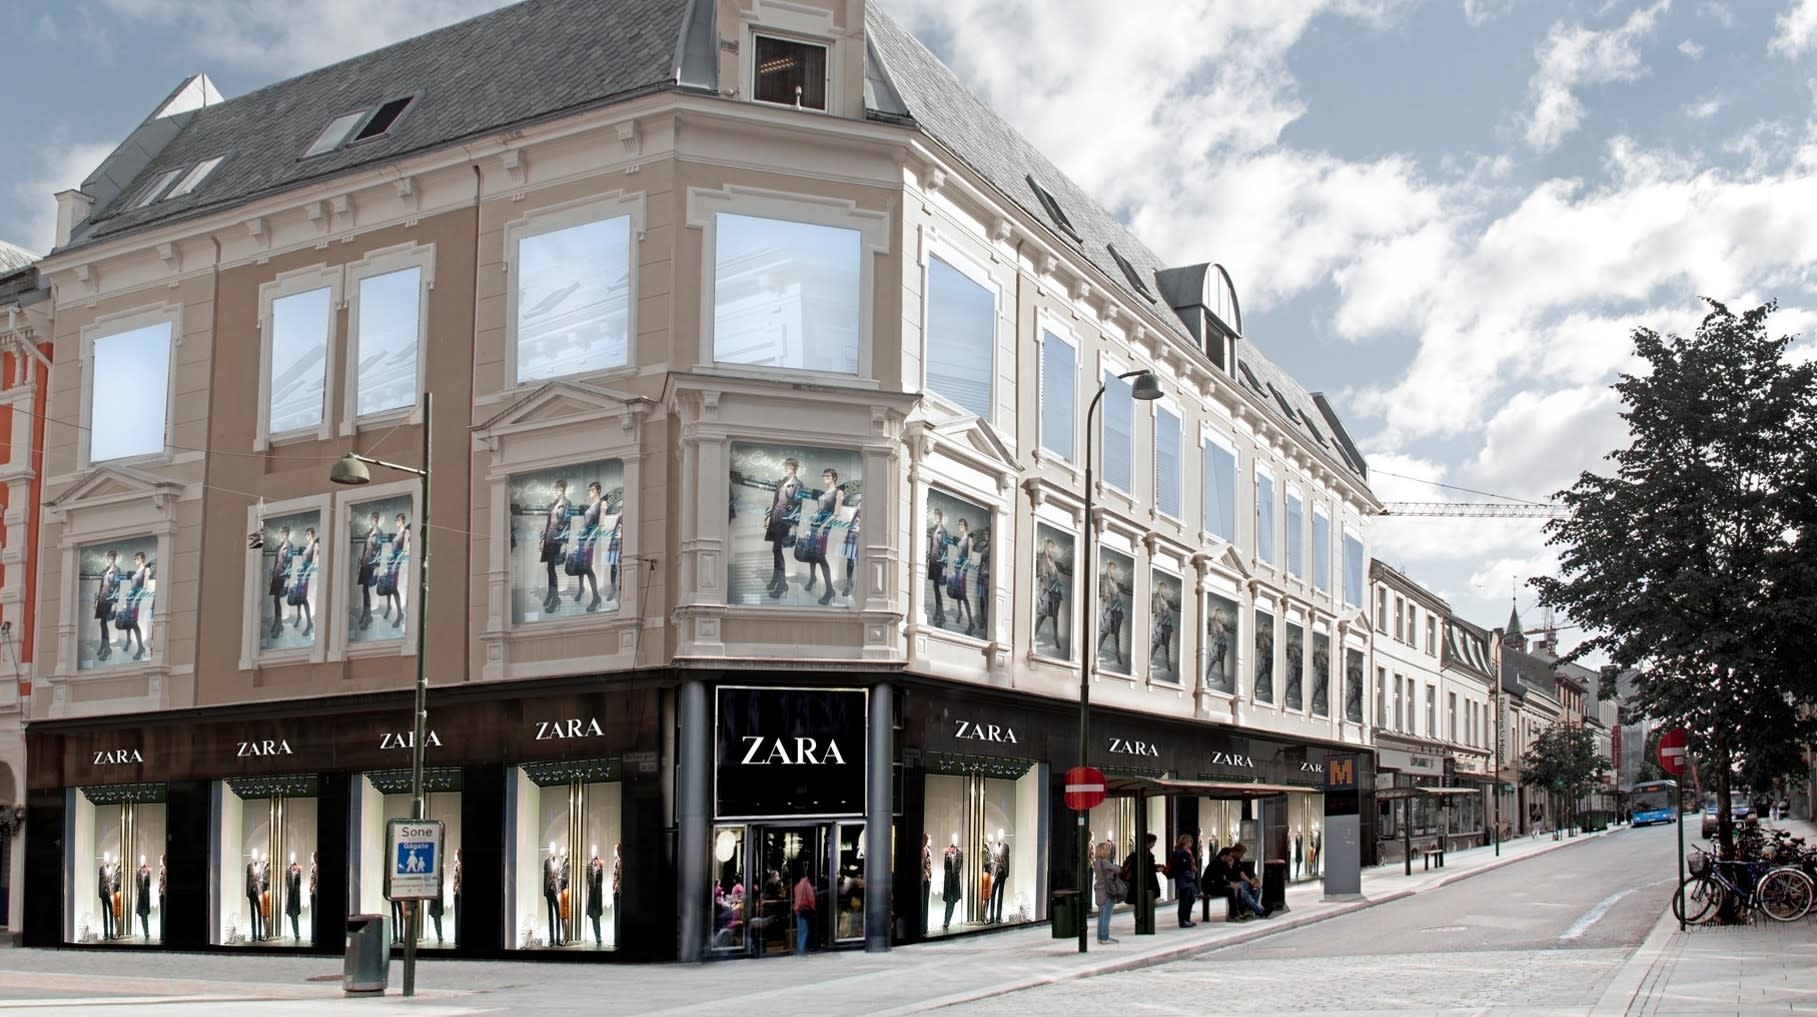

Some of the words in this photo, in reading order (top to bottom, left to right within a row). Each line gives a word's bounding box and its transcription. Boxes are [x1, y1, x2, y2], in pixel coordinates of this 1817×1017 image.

[535, 717, 605, 740] ZARA
[954, 720, 1018, 743] ZARA
[237, 739, 293, 757] ZARA
[741, 736, 847, 765] ZARA
[1109, 738, 1160, 757] ZARA
[93, 749, 144, 765] ZARA
[1211, 751, 1254, 767] ZARA
[1300, 762, 1325, 773] ZAR
[1330, 759, 1352, 785] M
[401, 826, 433, 837] Sone
